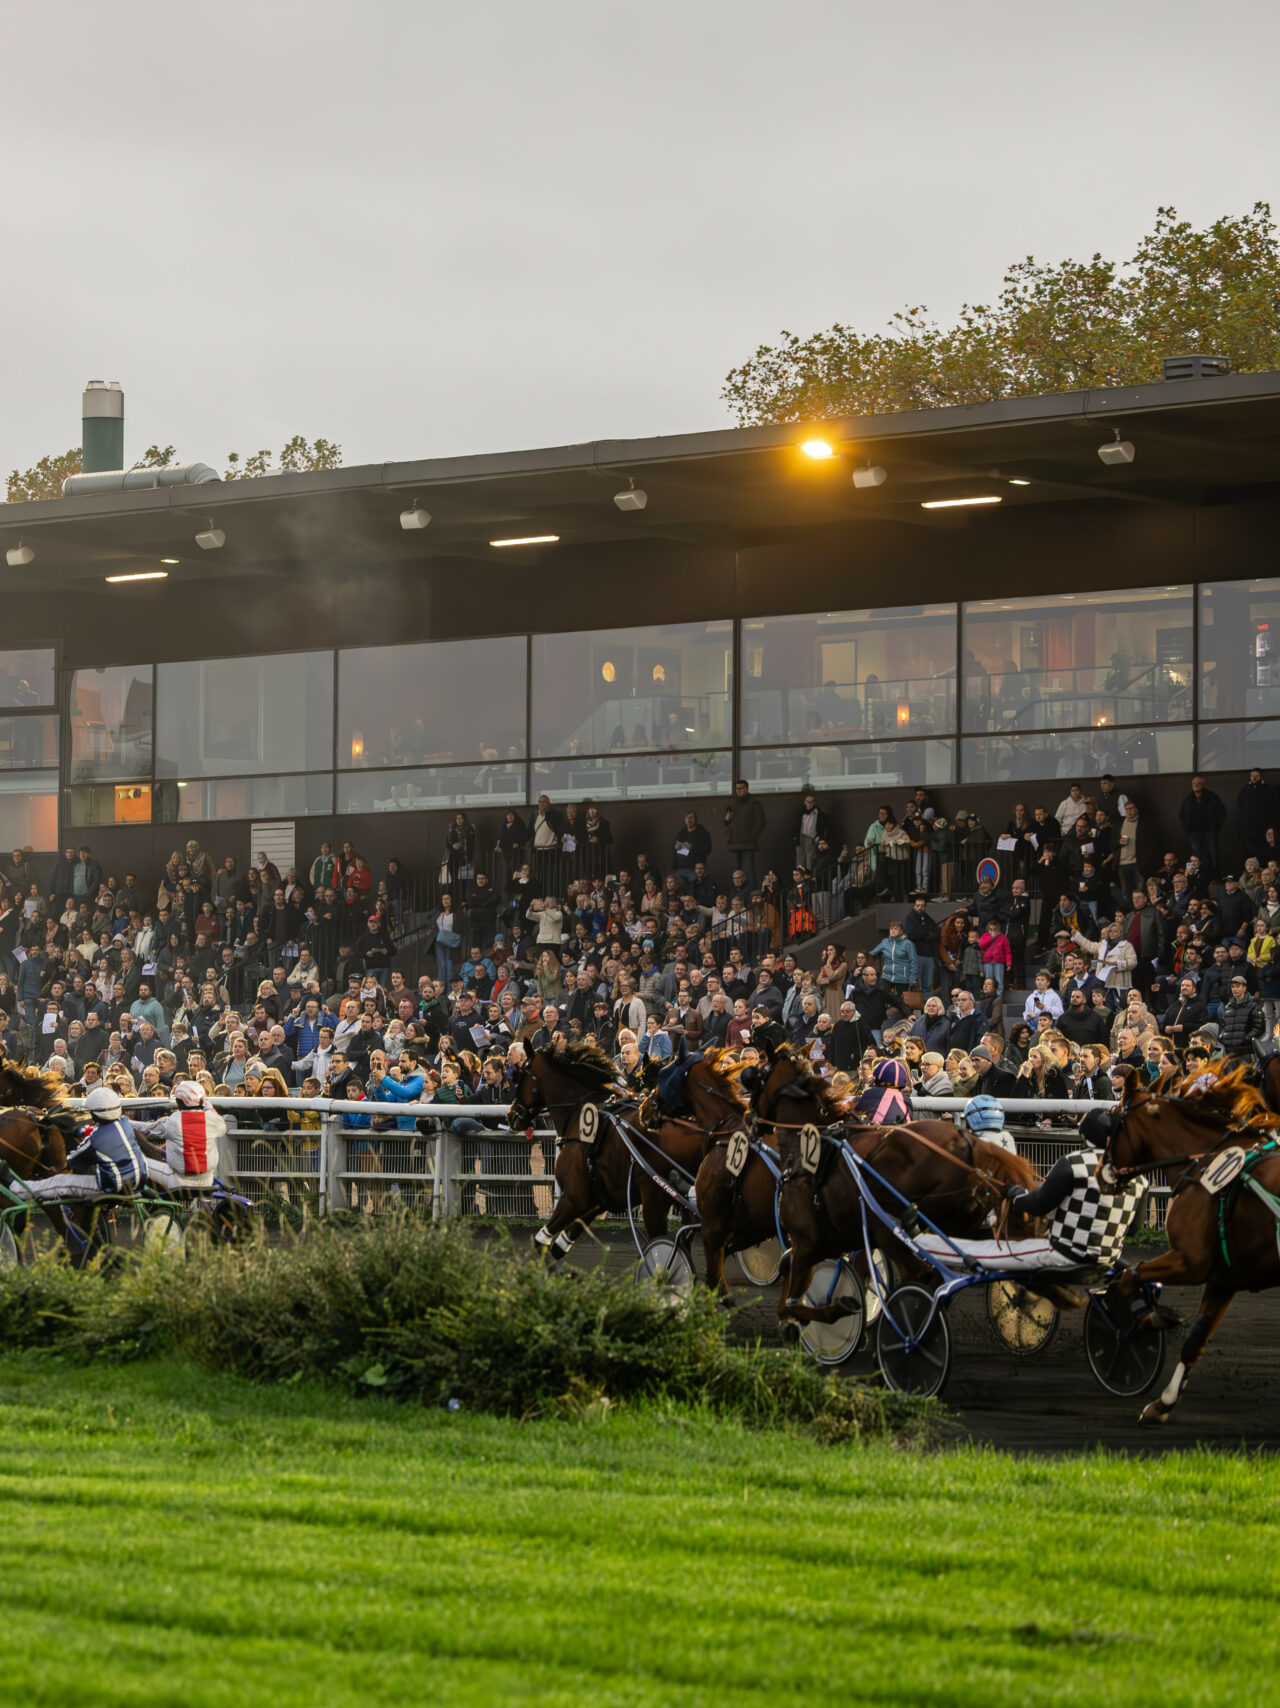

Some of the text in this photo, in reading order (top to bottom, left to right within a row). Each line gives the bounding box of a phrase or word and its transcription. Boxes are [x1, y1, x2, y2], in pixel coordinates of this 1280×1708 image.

[583, 1106, 595, 1137] 9
[730, 1135, 746, 1170] 15
[804, 1127, 818, 1167] 12
[652, 1175, 677, 1197] CUSTOM
[1207, 1151, 1242, 1187] 10
